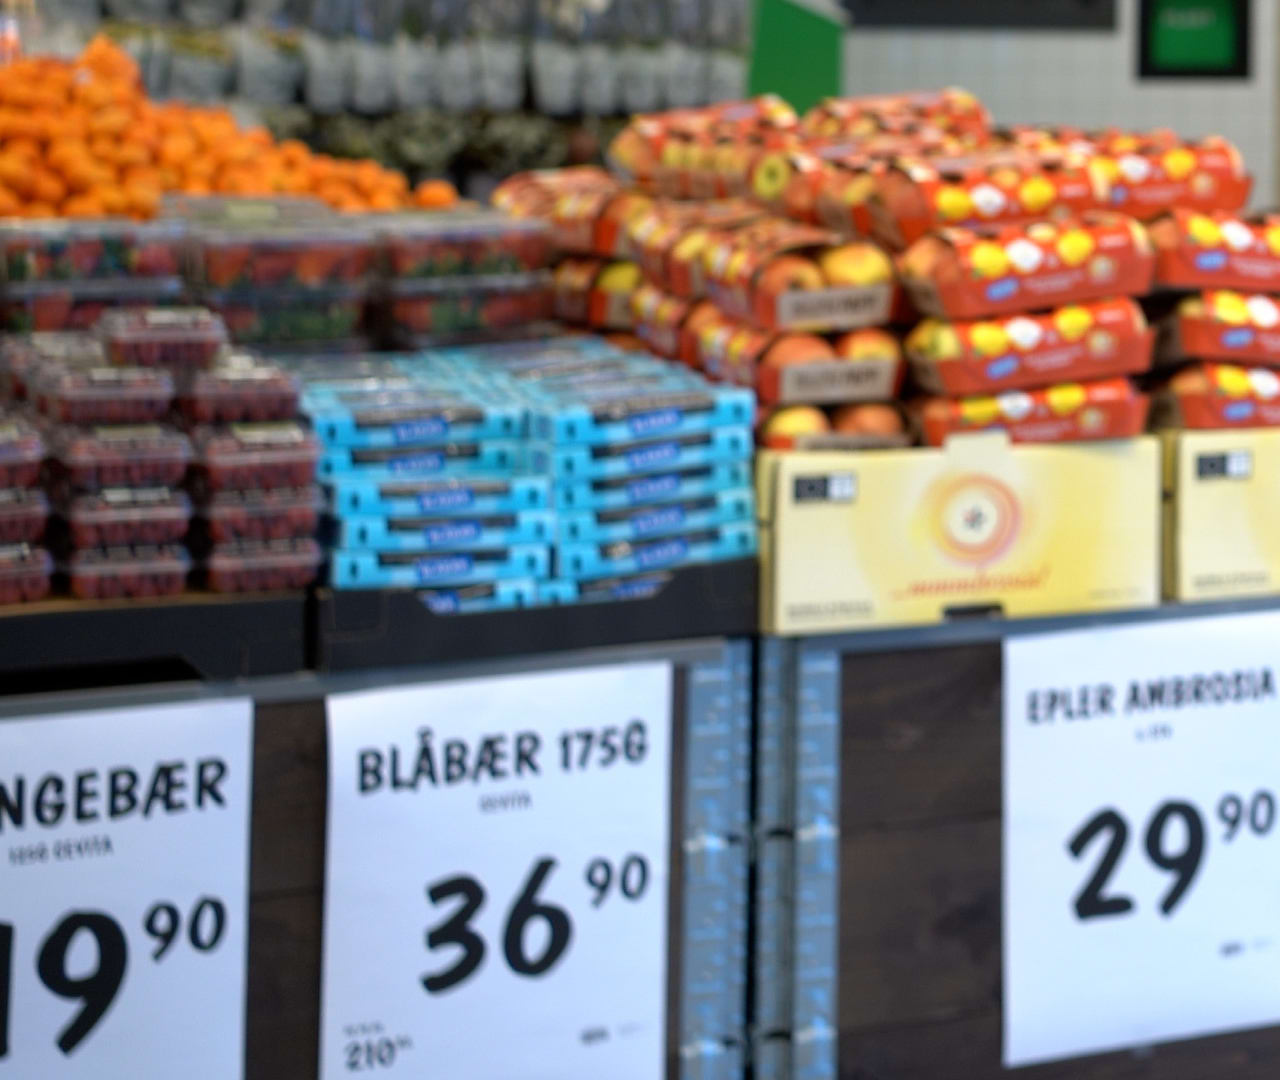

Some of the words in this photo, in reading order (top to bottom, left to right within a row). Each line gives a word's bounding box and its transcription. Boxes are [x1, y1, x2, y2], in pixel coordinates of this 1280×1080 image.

[1027, 683, 1116, 725] EPLER
[1124, 666, 1276, 717] AMBROSIA
[356, 724, 541, 795] BLÅBÆR
[559, 719, 649, 772] 175G
[1066, 802, 1208, 922] 29
[1217, 790, 1276, 843] 90
[144, 895, 228, 963] 90
[421, 854, 574, 994] 36
[585, 852, 651, 908] 90
